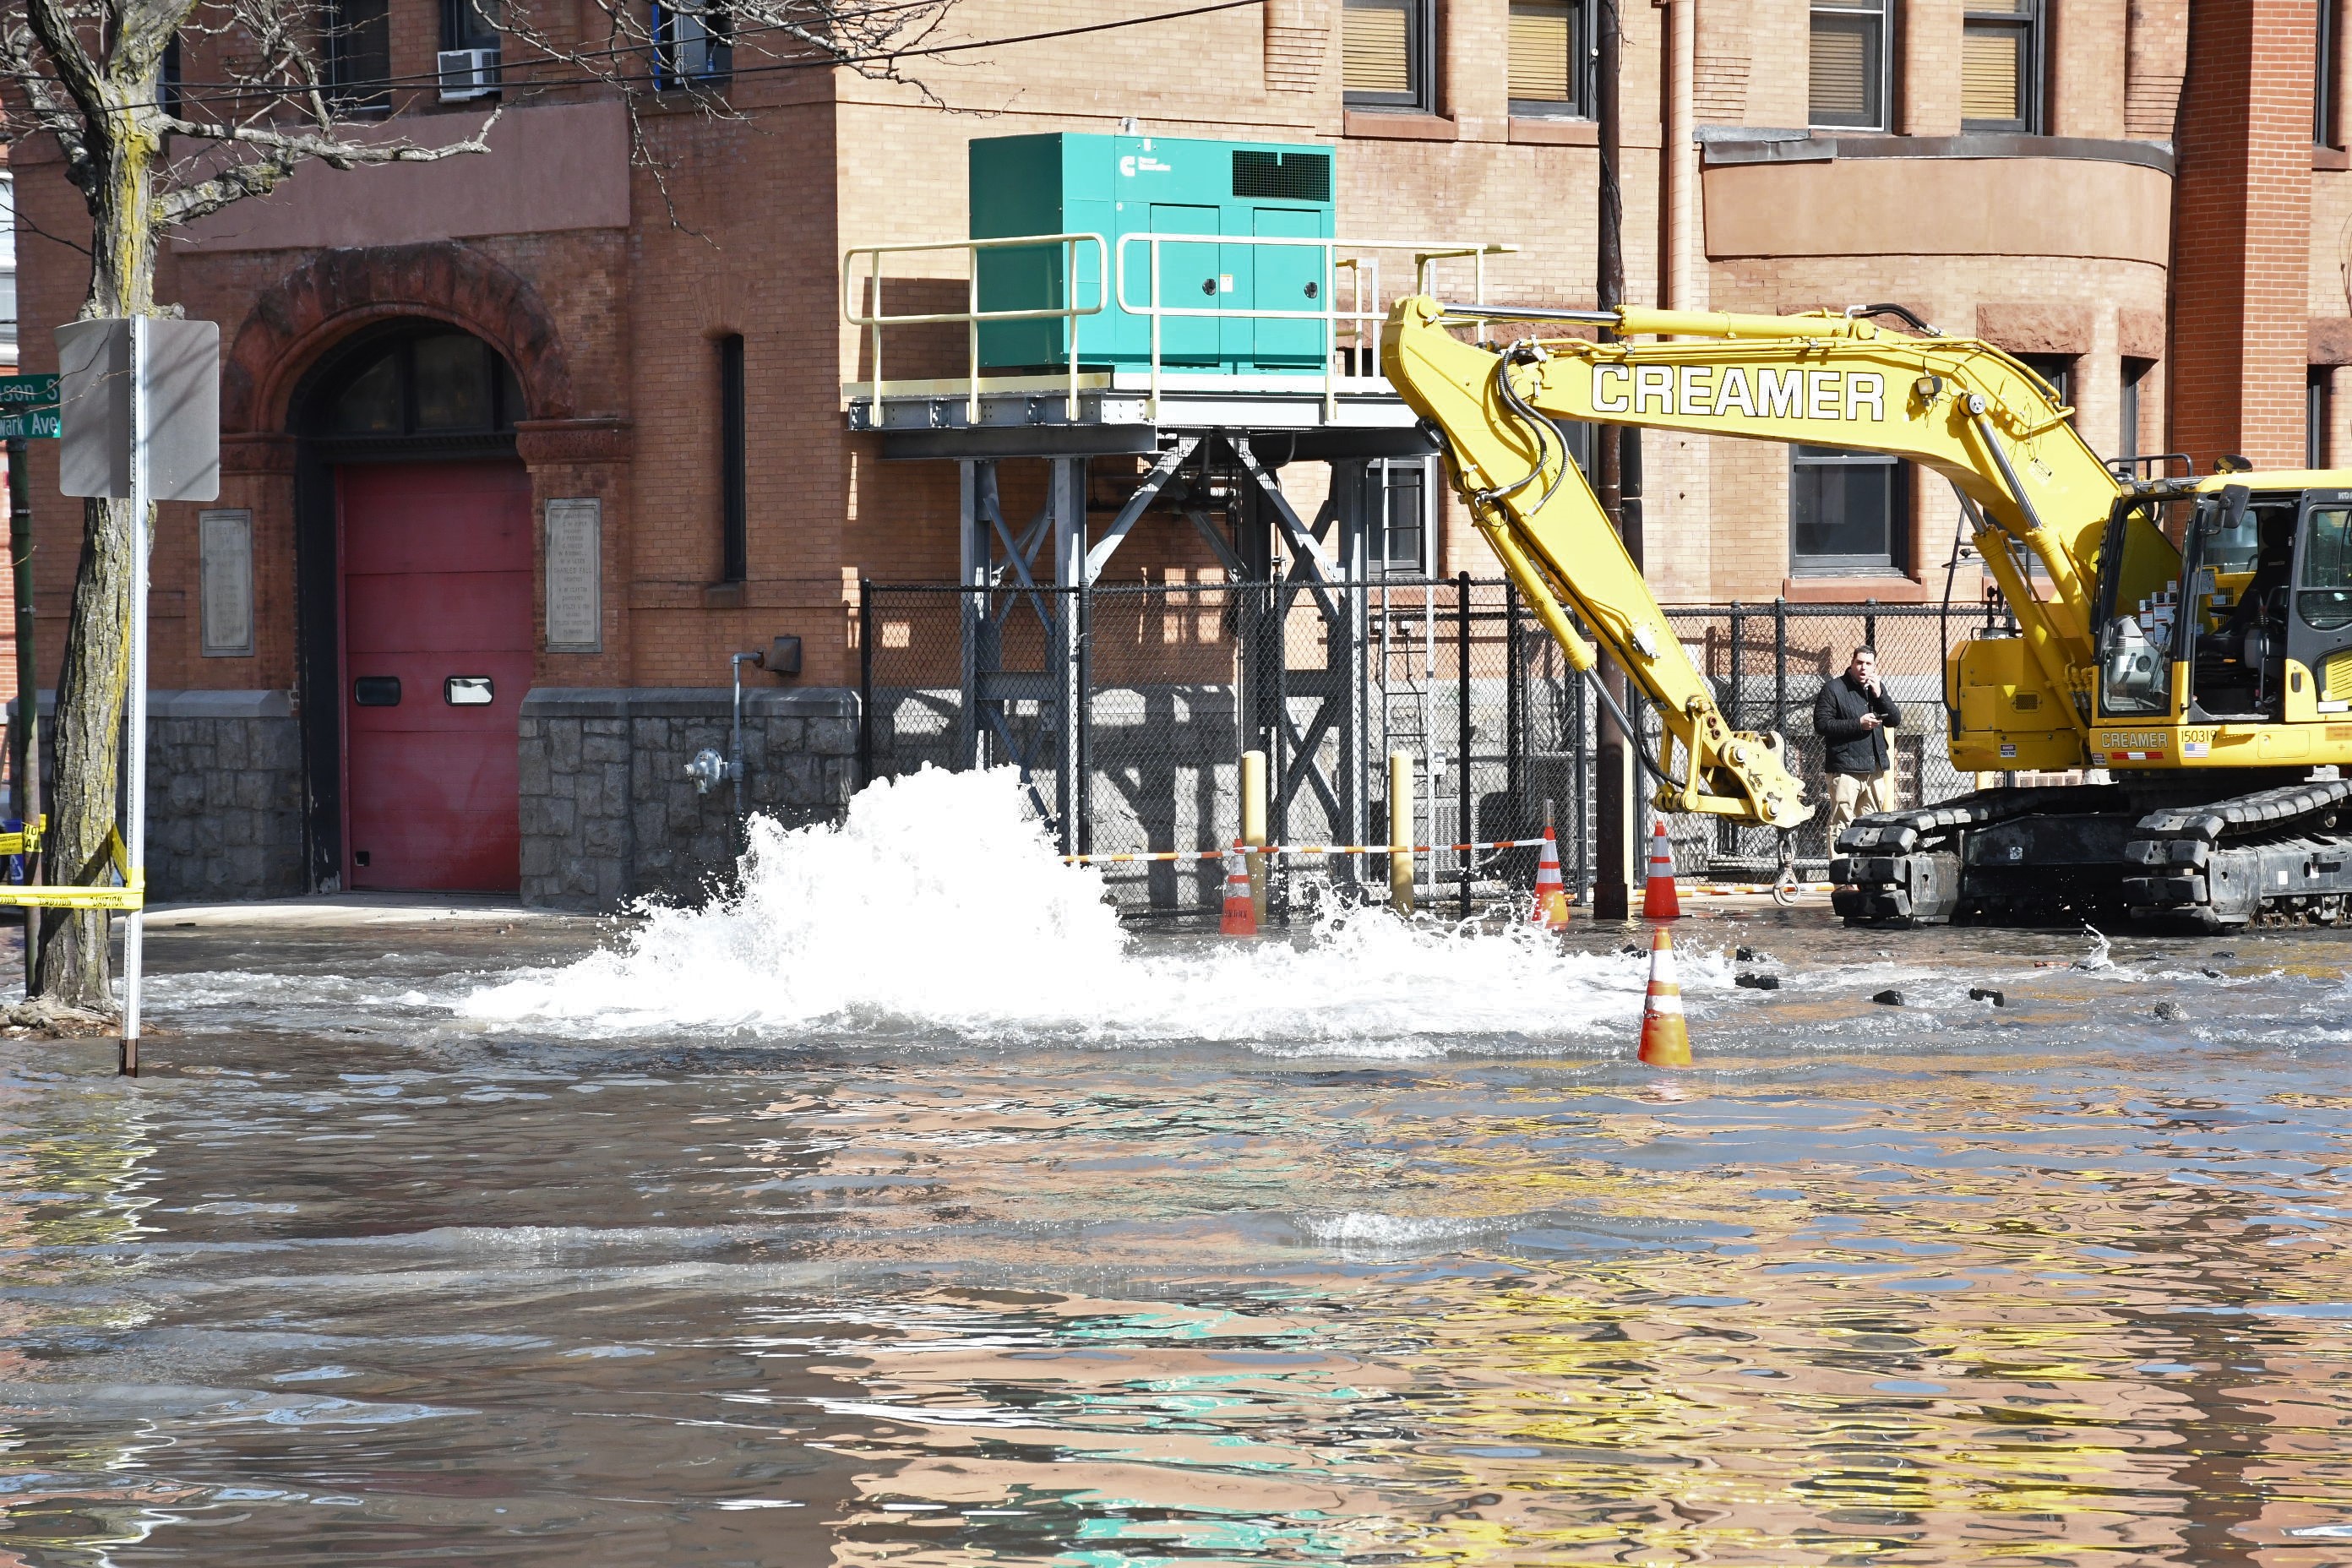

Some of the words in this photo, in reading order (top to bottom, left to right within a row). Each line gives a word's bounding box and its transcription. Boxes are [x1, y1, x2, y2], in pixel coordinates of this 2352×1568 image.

[0, 384, 35, 401] son
[46, 378, 59, 400] S
[1592, 363, 1885, 422] CREAMER
[31, 412, 57, 434] Ave
[2101, 732, 2168, 748] CREAMER
[2181, 730, 2217, 742] 150319
